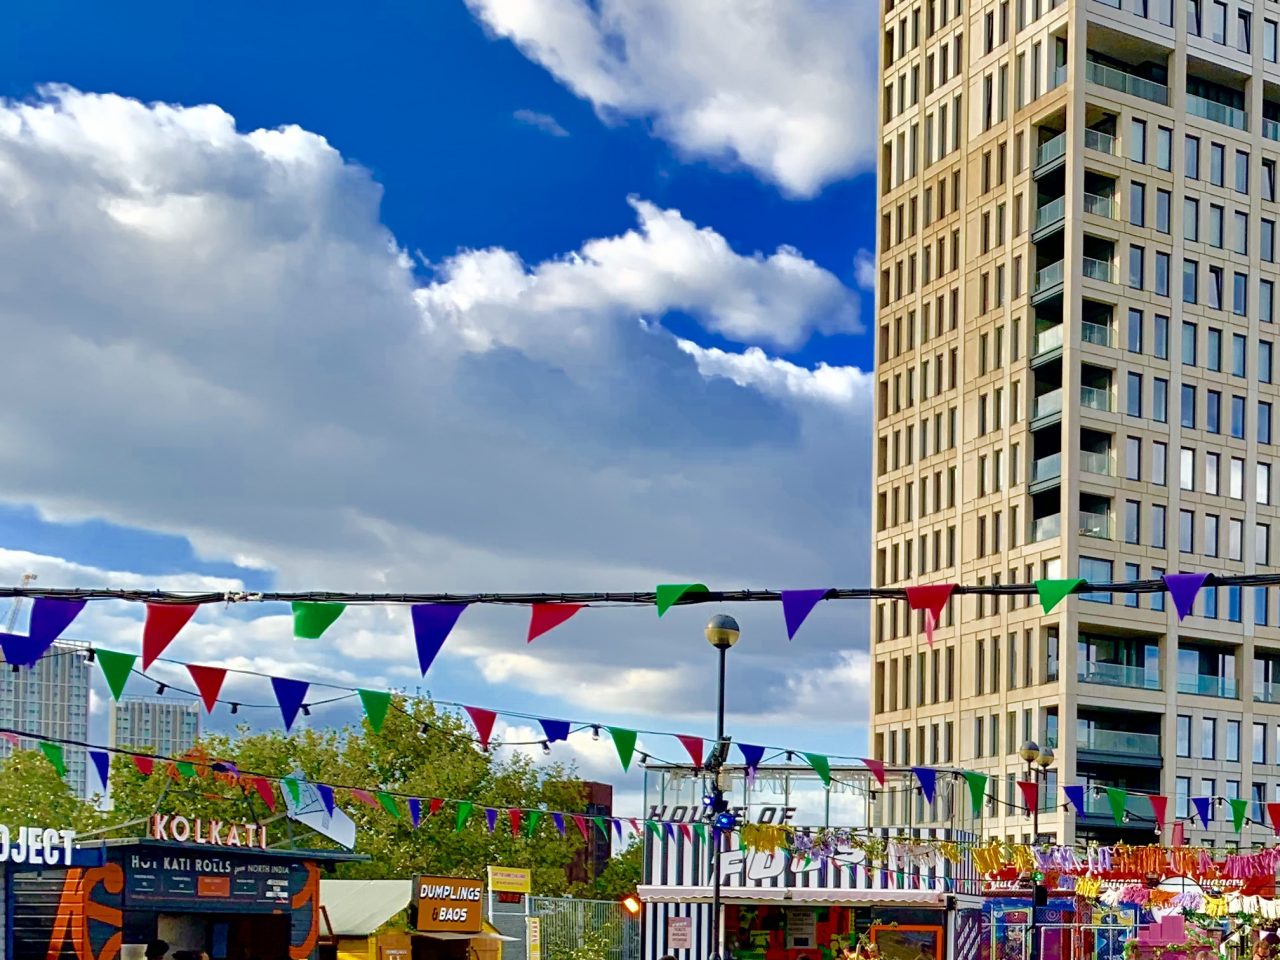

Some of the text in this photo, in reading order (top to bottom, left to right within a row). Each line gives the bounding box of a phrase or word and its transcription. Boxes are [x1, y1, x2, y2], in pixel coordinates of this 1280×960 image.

[757, 806, 796, 824] OF
[152, 812, 267, 849] KOLKATI
[164, 857, 190, 871] KATI
[195, 859, 231, 873] ROLLS
[247, 865, 270, 873] NORTH
[271, 865, 290, 874] INDIA
[420, 884, 481, 901] DUMPLINGS
[439, 907, 468, 921] BAOS
